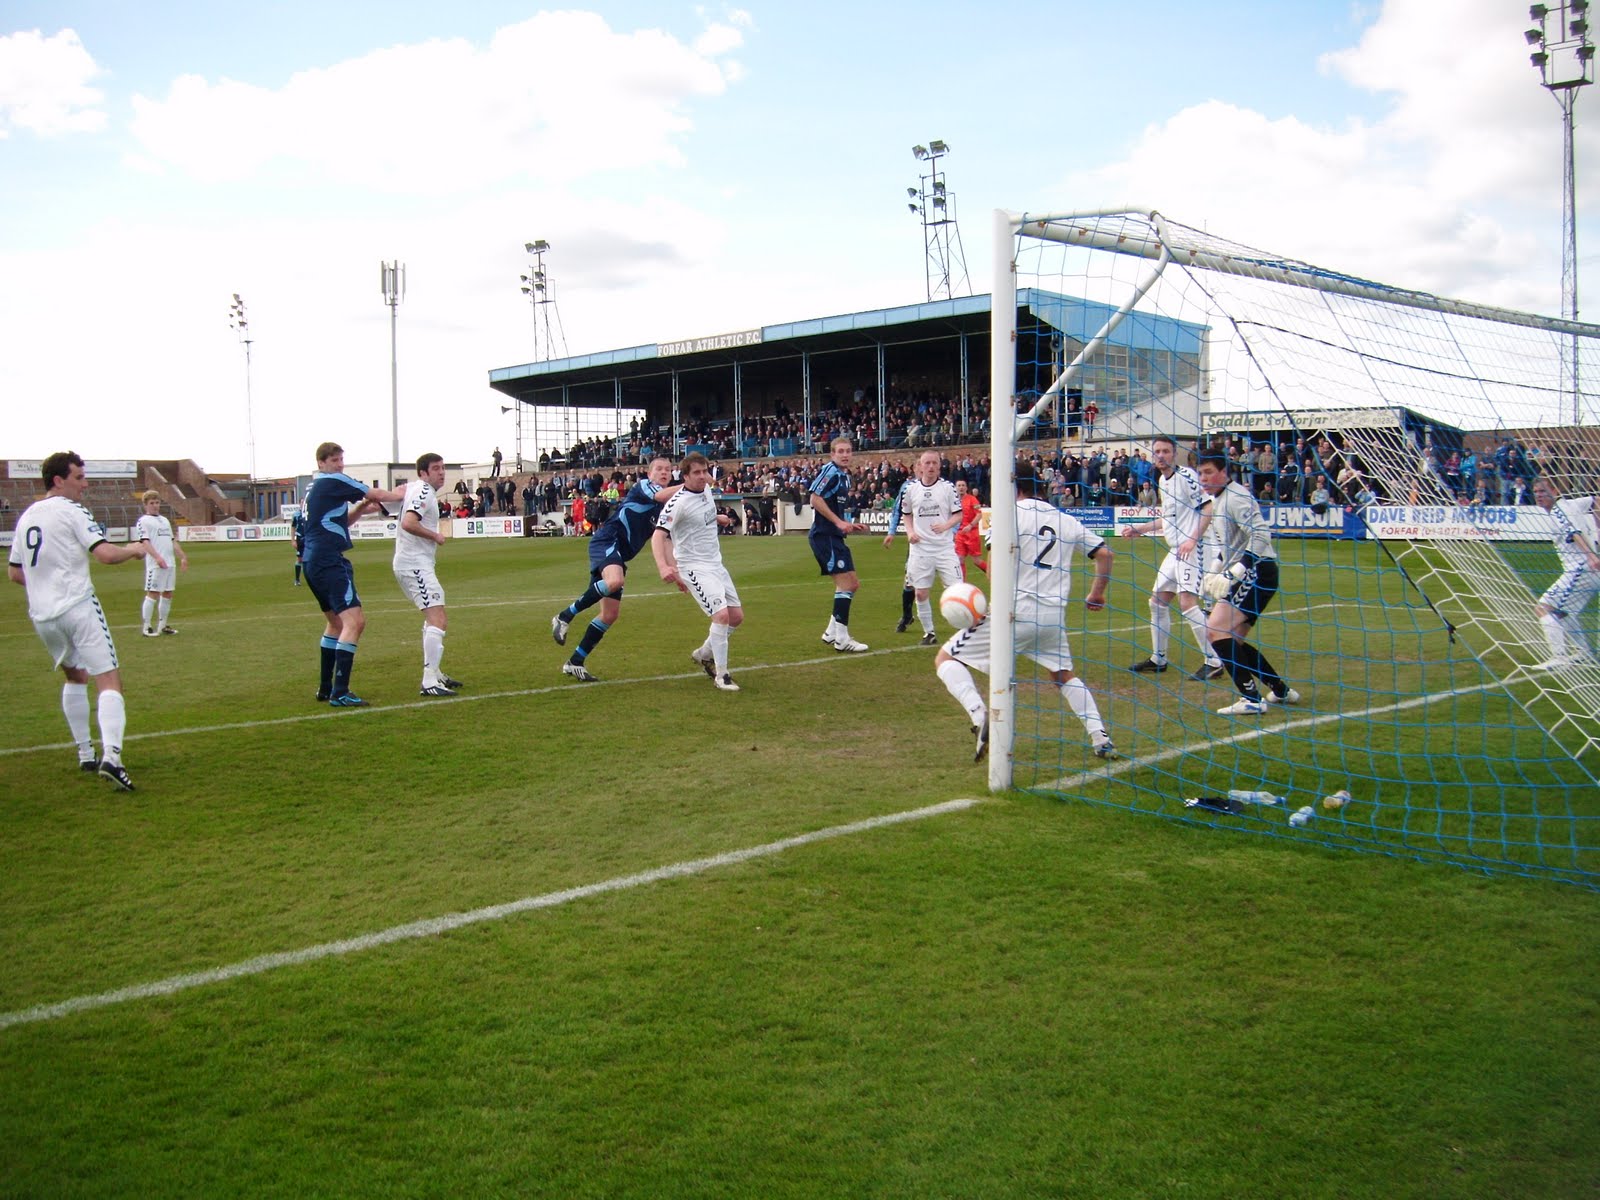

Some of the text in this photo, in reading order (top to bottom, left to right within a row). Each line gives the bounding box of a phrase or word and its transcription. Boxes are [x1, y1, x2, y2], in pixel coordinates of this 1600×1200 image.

[657, 331, 762, 357] FORFAR ATHLETIC F.C.
[1207, 413, 1272, 427] Saddler's
[1274, 416, 1286, 428] of
[1121, 508, 1141, 517] ROY
[1369, 507, 1518, 524] DAVE REID MOTORS
[1380, 527, 1419, 535] FORFAR
[26, 526, 43, 568] 9
[1032, 525, 1057, 571] 2
[1183, 568, 1191, 582] 5
